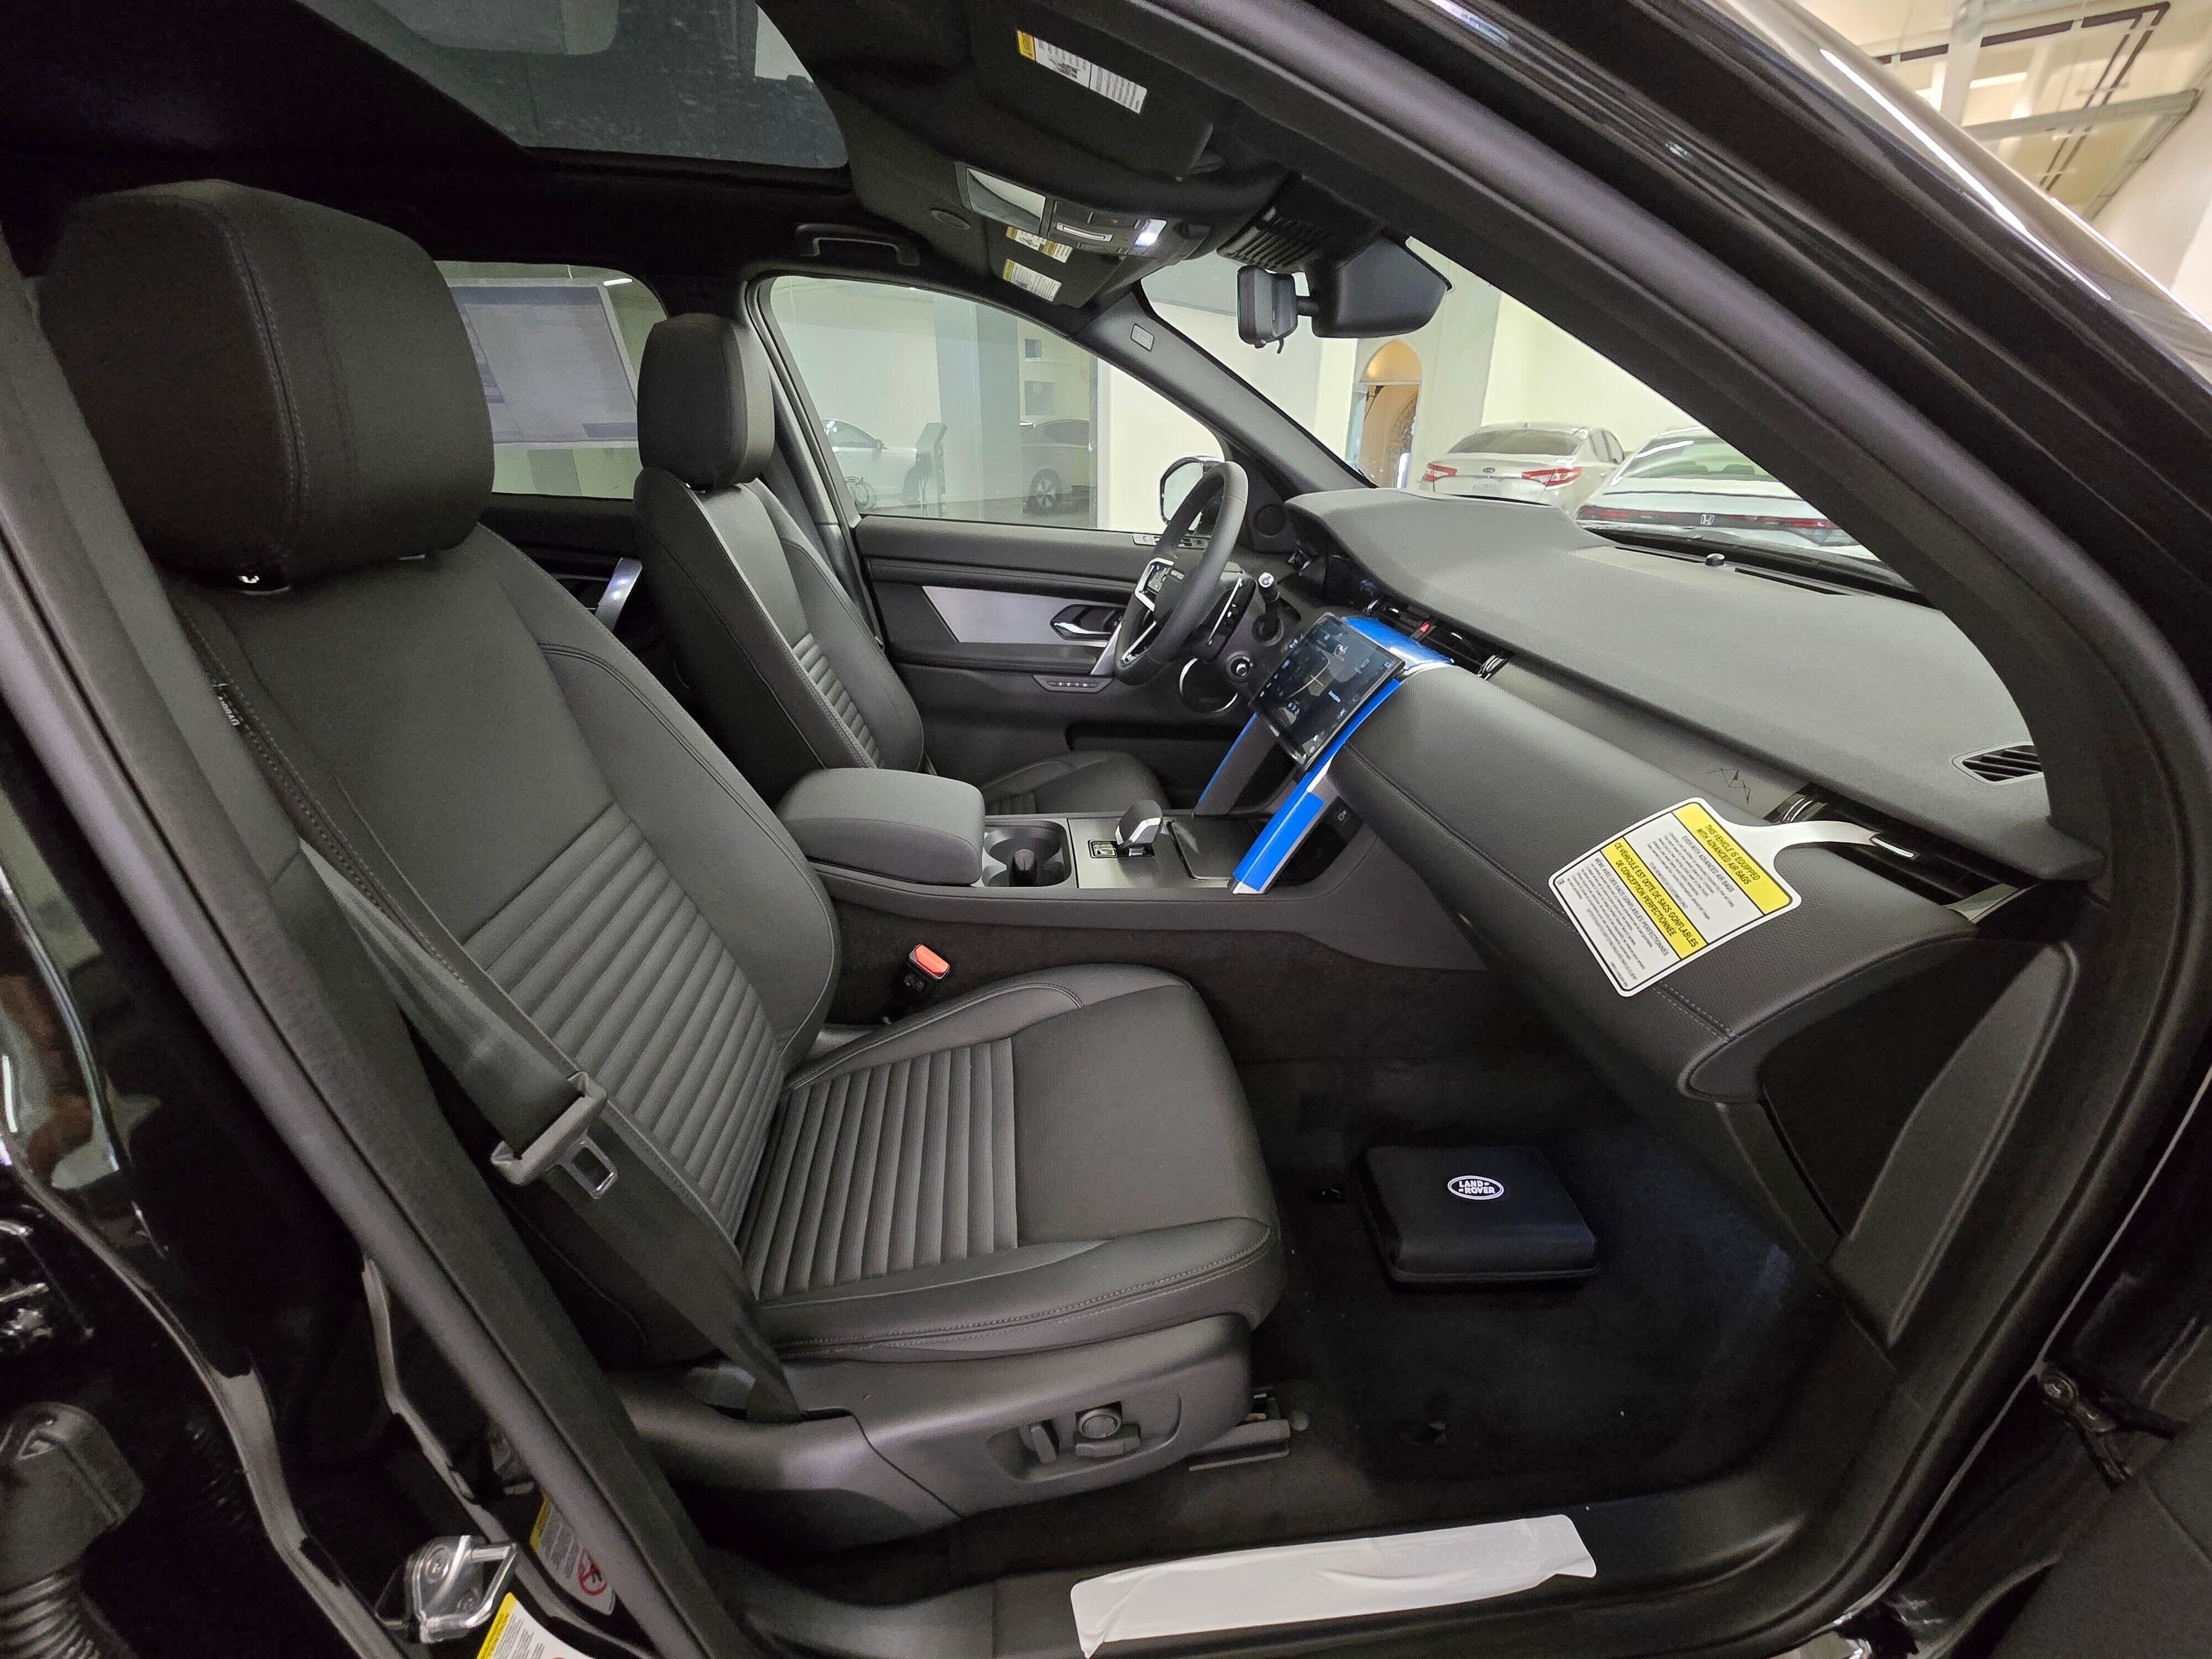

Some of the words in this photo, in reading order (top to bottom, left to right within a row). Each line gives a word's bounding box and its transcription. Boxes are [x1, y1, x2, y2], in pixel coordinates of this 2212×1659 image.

[1695, 827, 1710, 839] WITH
[1705, 838, 1731, 863] ADVANCED
[1726, 861, 1739, 872] AIR
[1734, 869, 1752, 885] BAGS
[1697, 853, 1719, 874] ADVANCED
[1715, 873, 1725, 881] AIR
[1720, 880, 1735, 893] BAGS
[1704, 824, 1717, 835] THIS
[1713, 833, 1734, 853] VEHICLE
[1734, 855, 1761, 881] EQUIPPED
[1608, 877, 1618, 886] DES
[1614, 884, 1625, 896] SACS
[1621, 895, 1645, 922] GONFLABLES
[1614, 841, 1624, 850] CE
[1634, 868, 1646, 879] EST
[1651, 890, 1662, 900] DE
[1657, 898, 1672, 913] SACS
[1667, 911, 1699, 948] GONFLABLES
[1615, 859, 1625, 868] DE
[1620, 865, 1646, 896] CONCEPTION
[1464, 1186, 1496, 1194] ROVER
